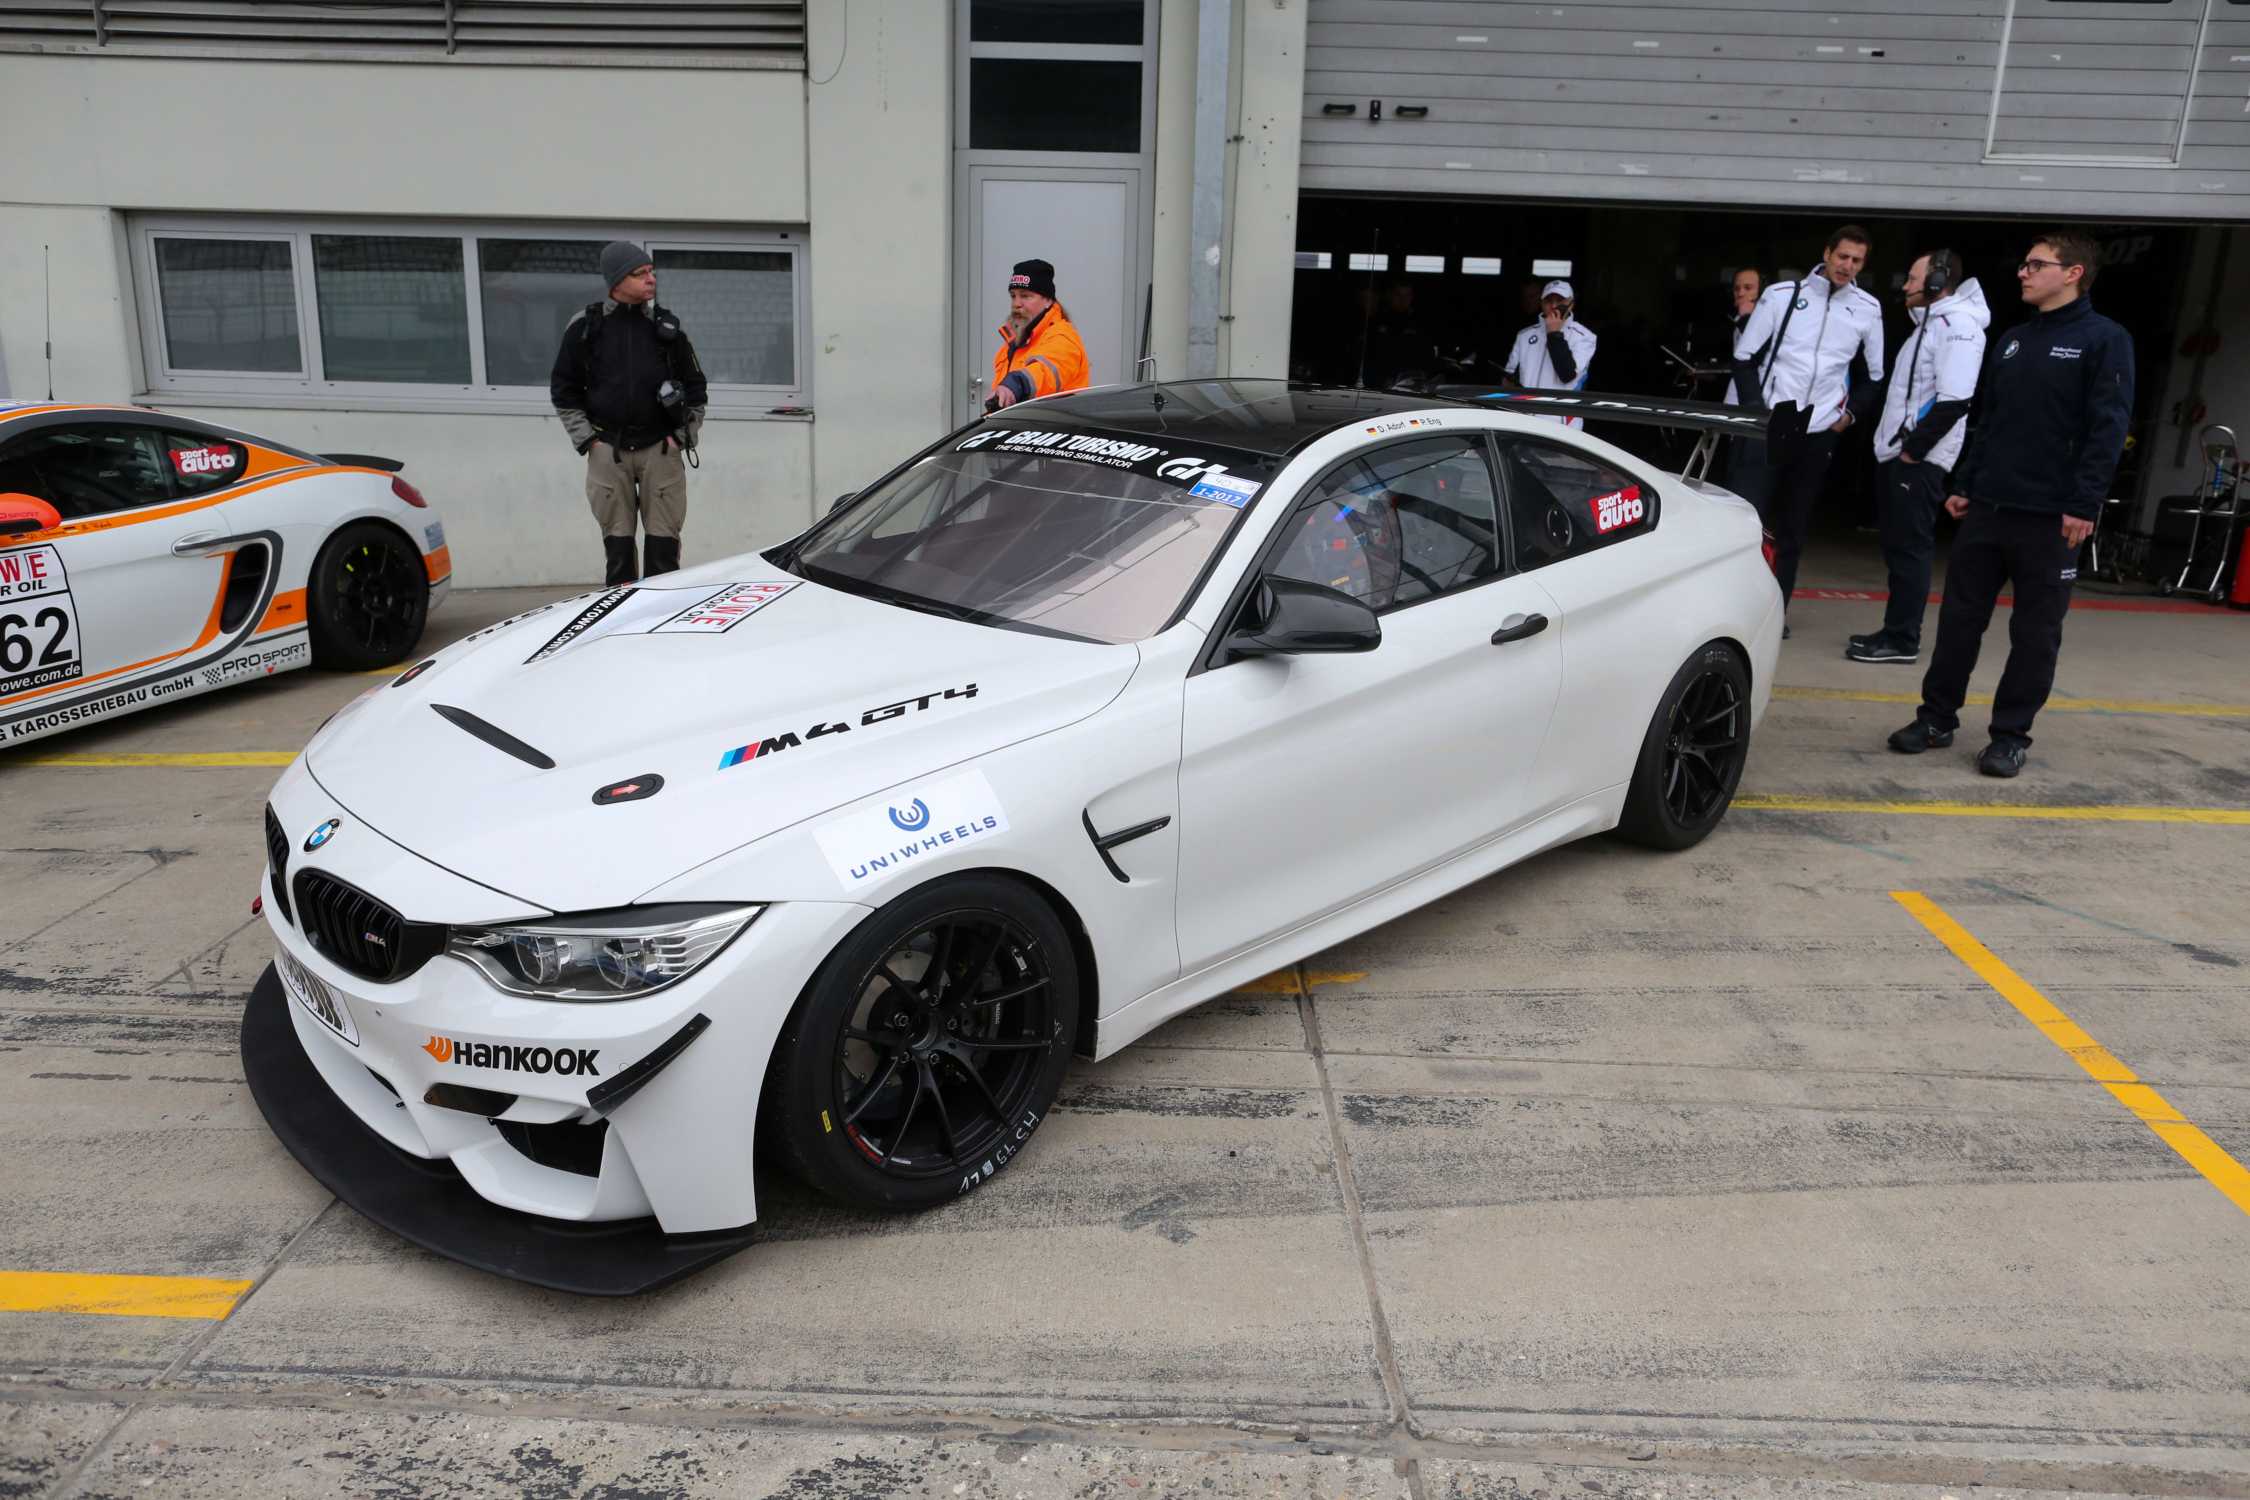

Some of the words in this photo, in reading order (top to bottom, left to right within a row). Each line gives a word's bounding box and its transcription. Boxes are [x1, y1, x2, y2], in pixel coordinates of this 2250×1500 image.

[180, 448, 209, 461] sport
[1004, 431, 1069, 447] GRAN
[1057, 434, 1160, 462] TURISMO
[1011, 445, 1033, 453] REAL
[1034, 447, 1074, 457] DRIVING
[1073, 452, 1133, 469] SIMULATOR
[181, 453, 237, 473] auto
[1598, 491, 1623, 512] sport
[1599, 498, 1644, 530] auto
[18, 579, 48, 593] OIL
[674, 610, 705, 624] OIL
[690, 584, 785, 627] ROWE
[262, 642, 308, 662] SPORT
[0, 664, 81, 693] owe.com.de
[11, 688, 148, 738] KAROSSERIEBAU
[151, 675, 195, 697] GmbH
[756, 722, 851, 758] M4
[860, 683, 979, 727] GT4
[850, 815, 998, 879] UNIWHEELS
